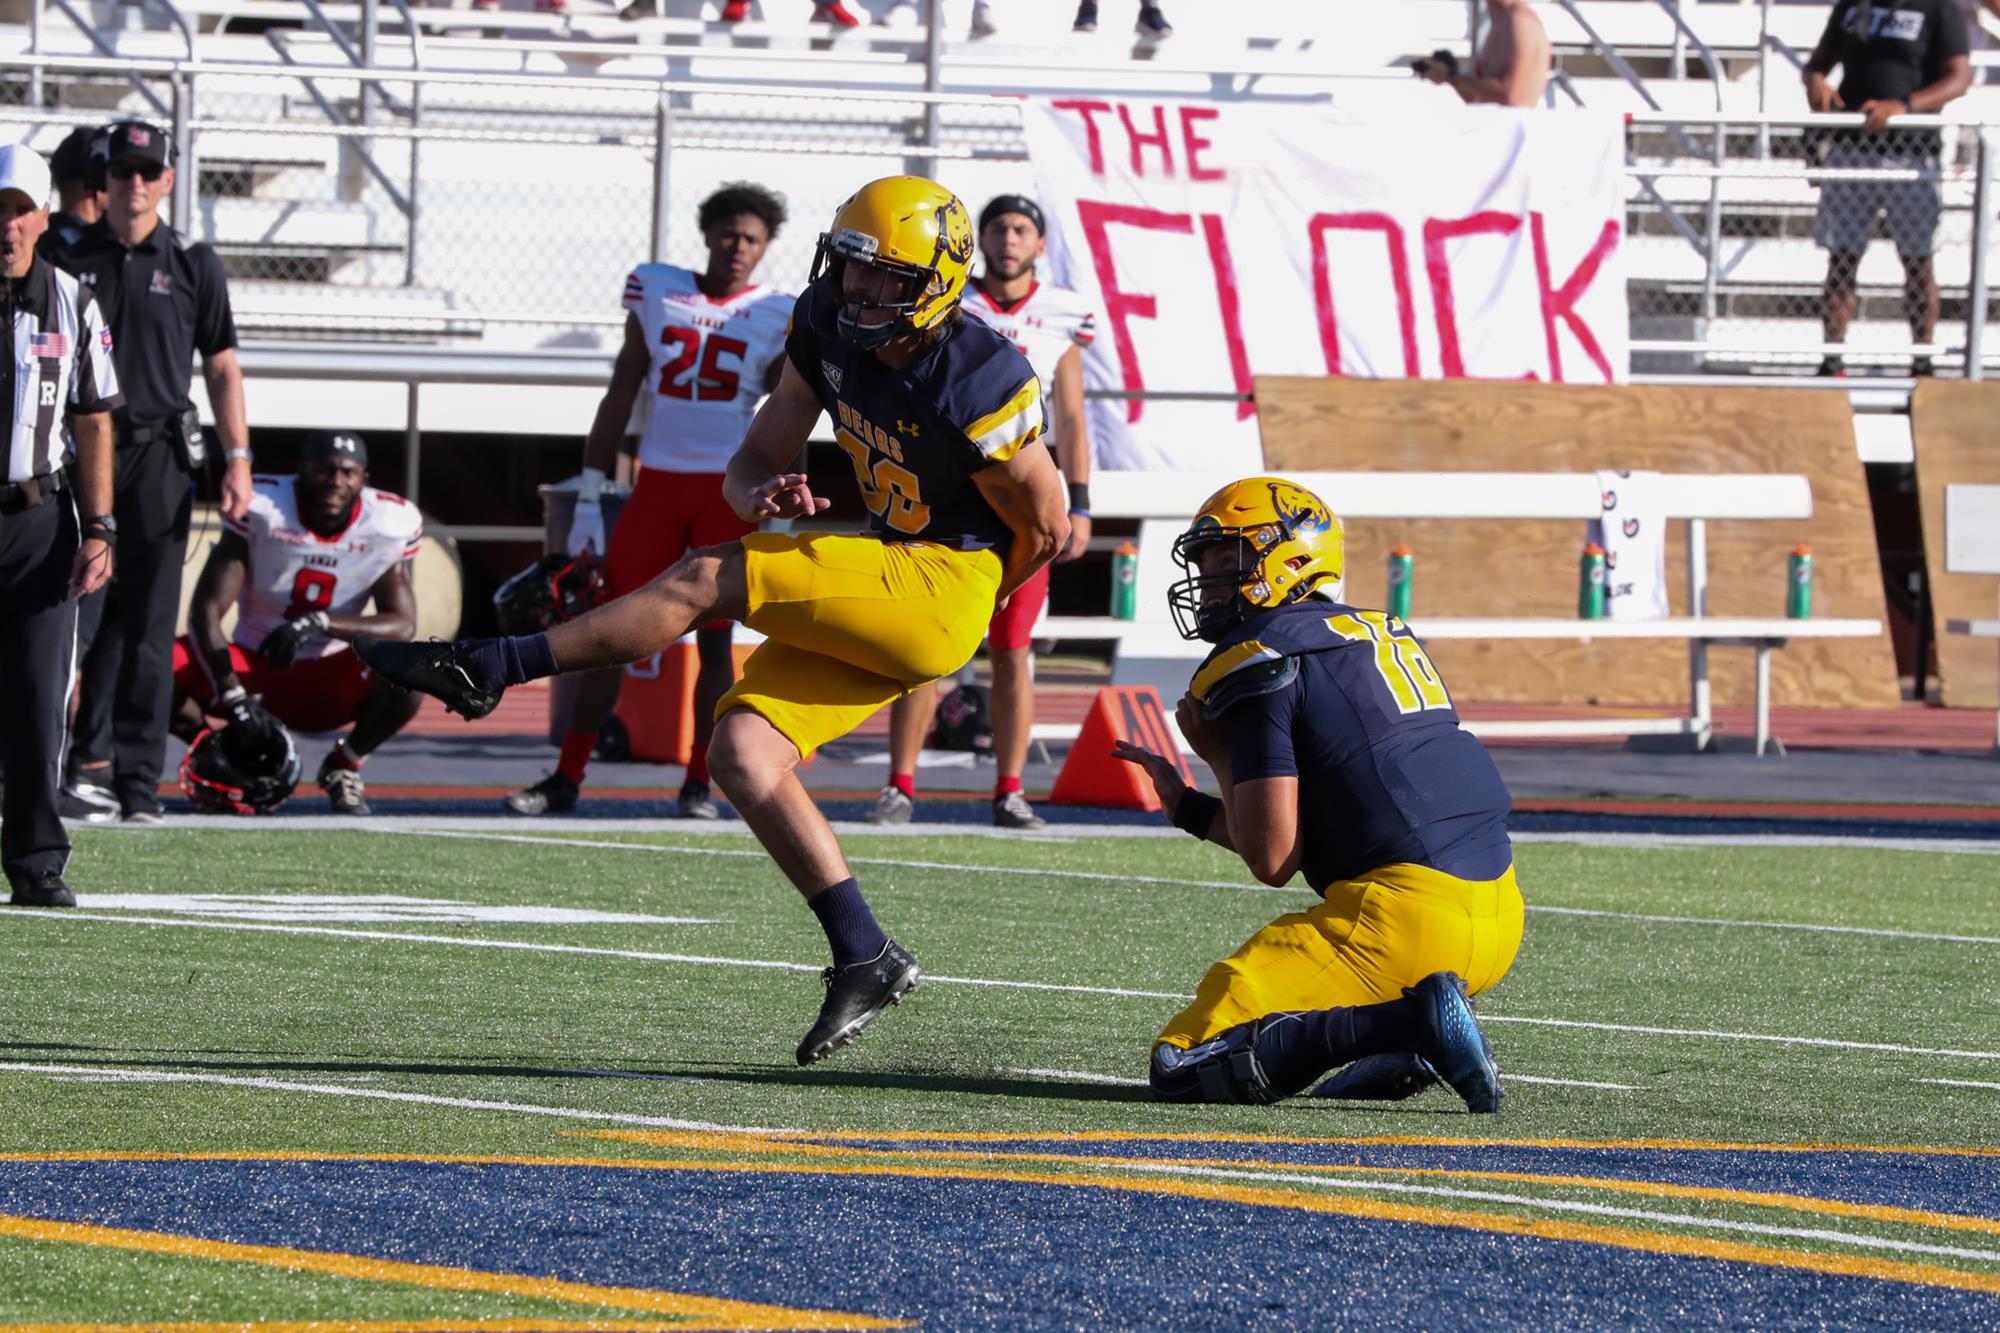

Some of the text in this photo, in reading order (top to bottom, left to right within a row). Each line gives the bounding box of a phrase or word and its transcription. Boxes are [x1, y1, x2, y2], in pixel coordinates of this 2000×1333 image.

[1053, 100, 1226, 181] THE
[40, 381, 56, 406] R
[658, 325, 748, 402] 25
[837, 399, 904, 463] BEARS
[1323, 611, 1452, 715] 16
